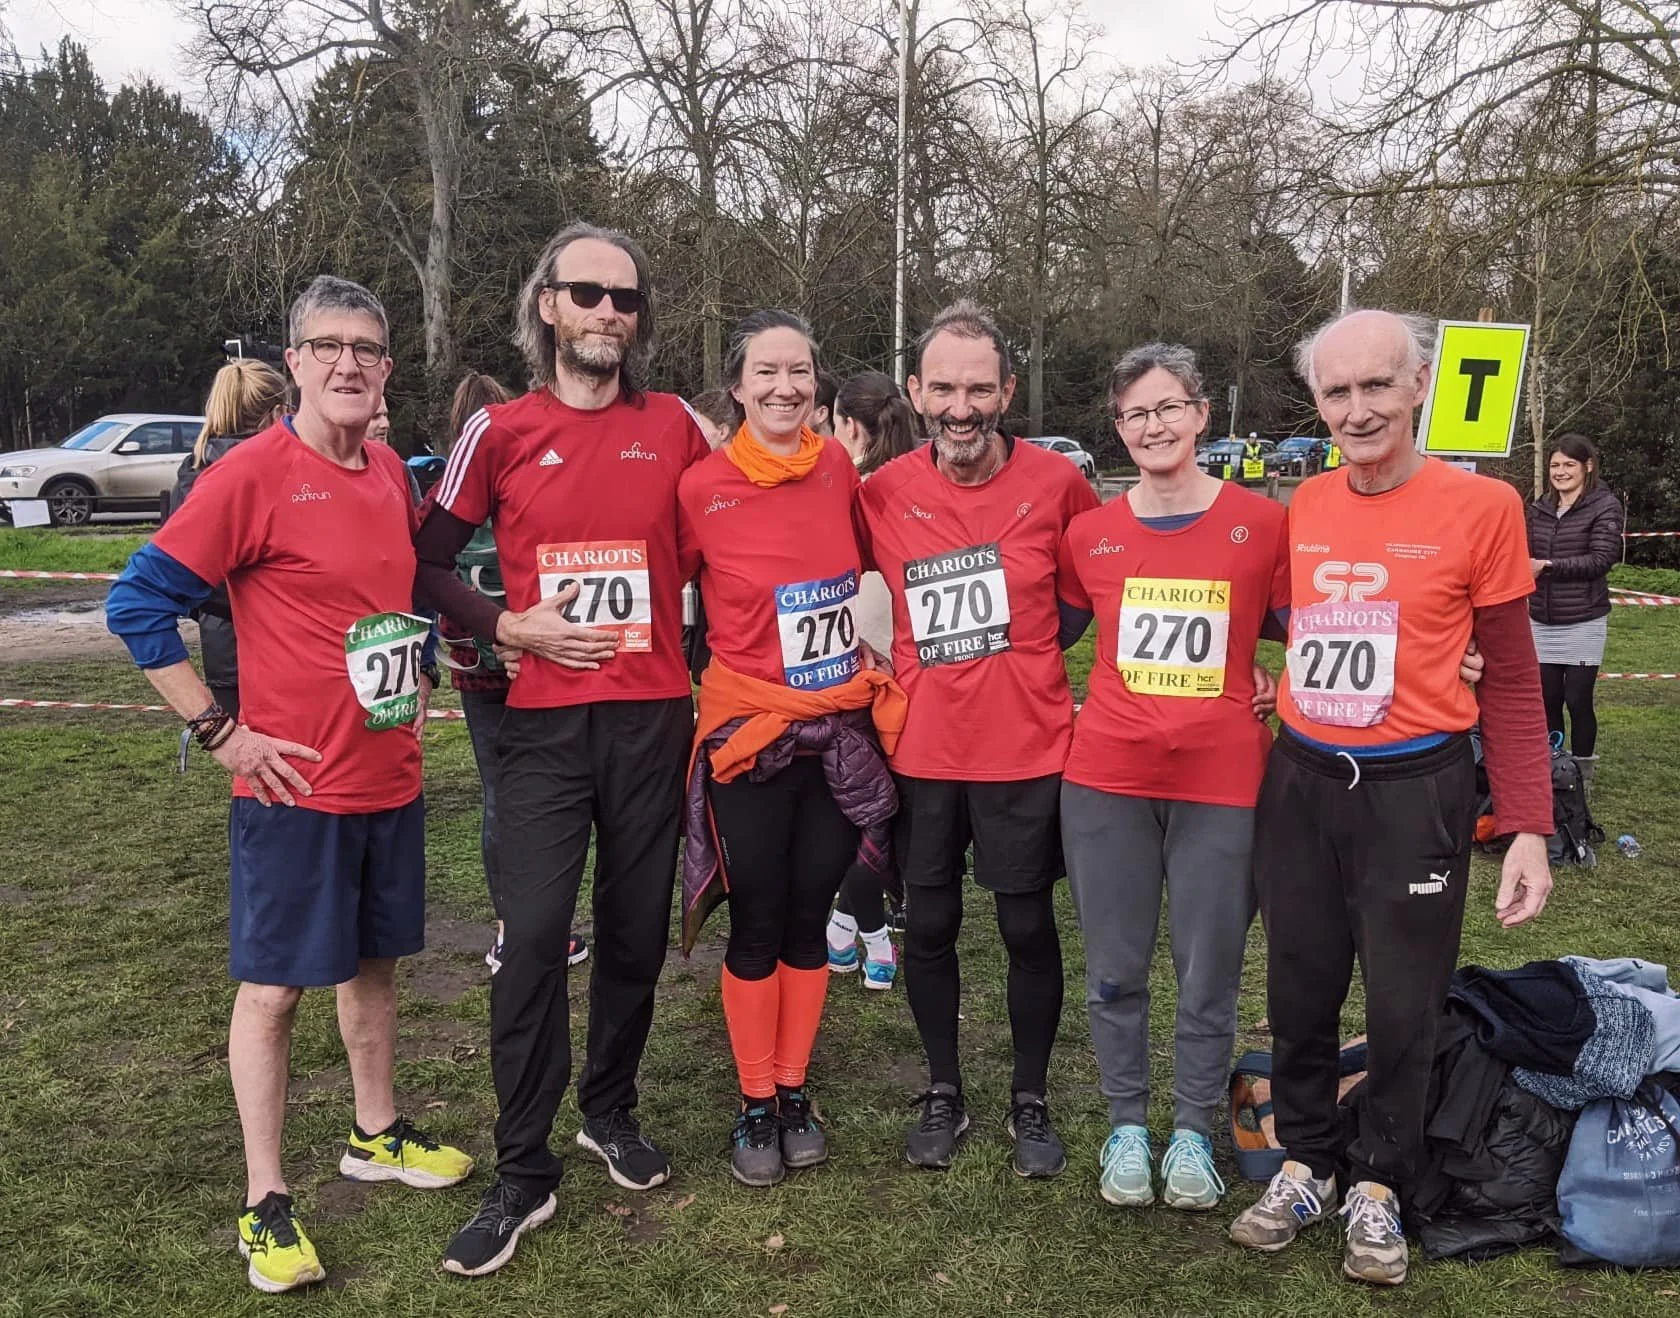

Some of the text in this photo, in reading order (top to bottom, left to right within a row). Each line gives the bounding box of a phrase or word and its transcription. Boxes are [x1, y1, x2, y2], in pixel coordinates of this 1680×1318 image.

[1459, 358, 1501, 422] T
[620, 441, 657, 461] parkrun
[541, 548, 642, 567] CHARIOTS
[1089, 537, 1125, 558] parkrun
[906, 550, 996, 581] CHARIOTS
[557, 576, 633, 624] 270
[780, 576, 855, 607] CHARIOTS
[1127, 586, 1225, 605] CHARIOTS
[921, 579, 993, 635] 270
[796, 605, 855, 662] 270
[1297, 610, 1393, 632] CHARIOTS
[919, 644, 940, 661] OF
[943, 635, 985, 656] FIRE
[1133, 612, 1212, 663] 270
[366, 641, 422, 701] 270
[790, 671, 814, 687] OF
[815, 660, 850, 682] FIRE
[1120, 669, 1143, 684] OF
[1147, 671, 1192, 688] FIRE
[1300, 640, 1376, 691] 270
[1316, 701, 1358, 718] FIRE
[1409, 881, 1443, 895] PUMA
